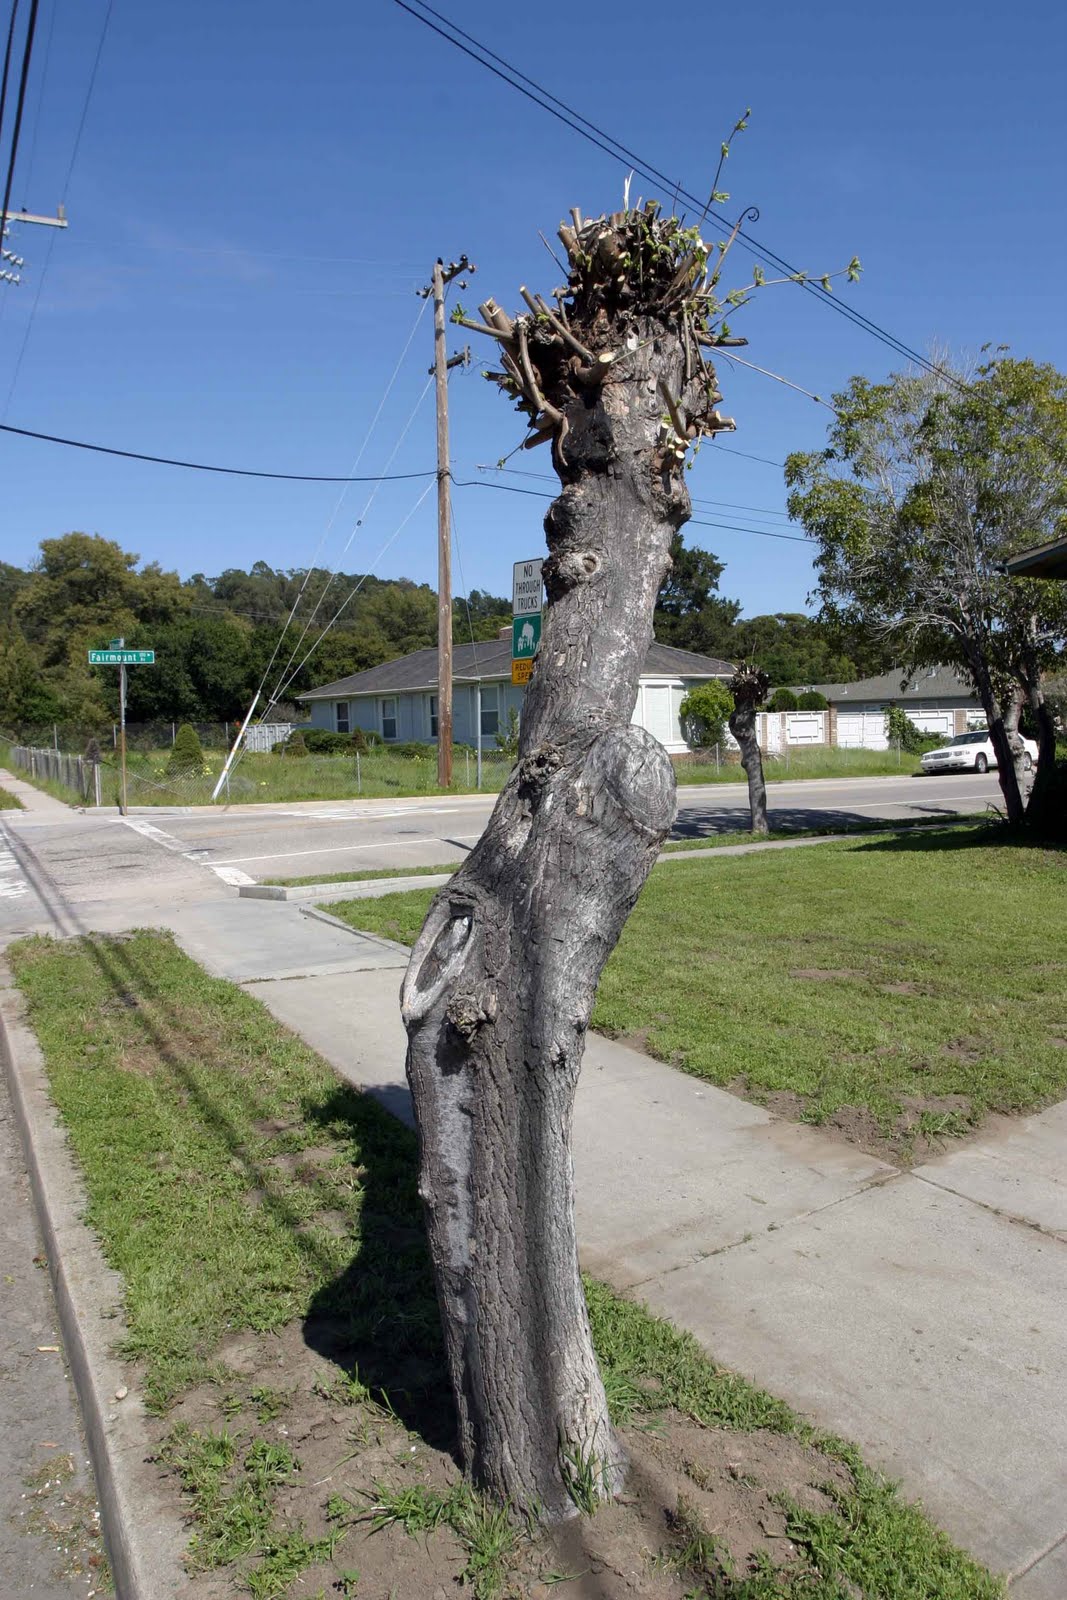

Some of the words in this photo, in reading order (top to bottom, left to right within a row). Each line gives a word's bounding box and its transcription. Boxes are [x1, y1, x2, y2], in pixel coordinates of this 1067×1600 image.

[523, 564, 533, 578] NO
[516, 580, 540, 595] THROUGH
[517, 596, 538, 610] TRUCKS
[91, 652, 137, 662] Fairmount
